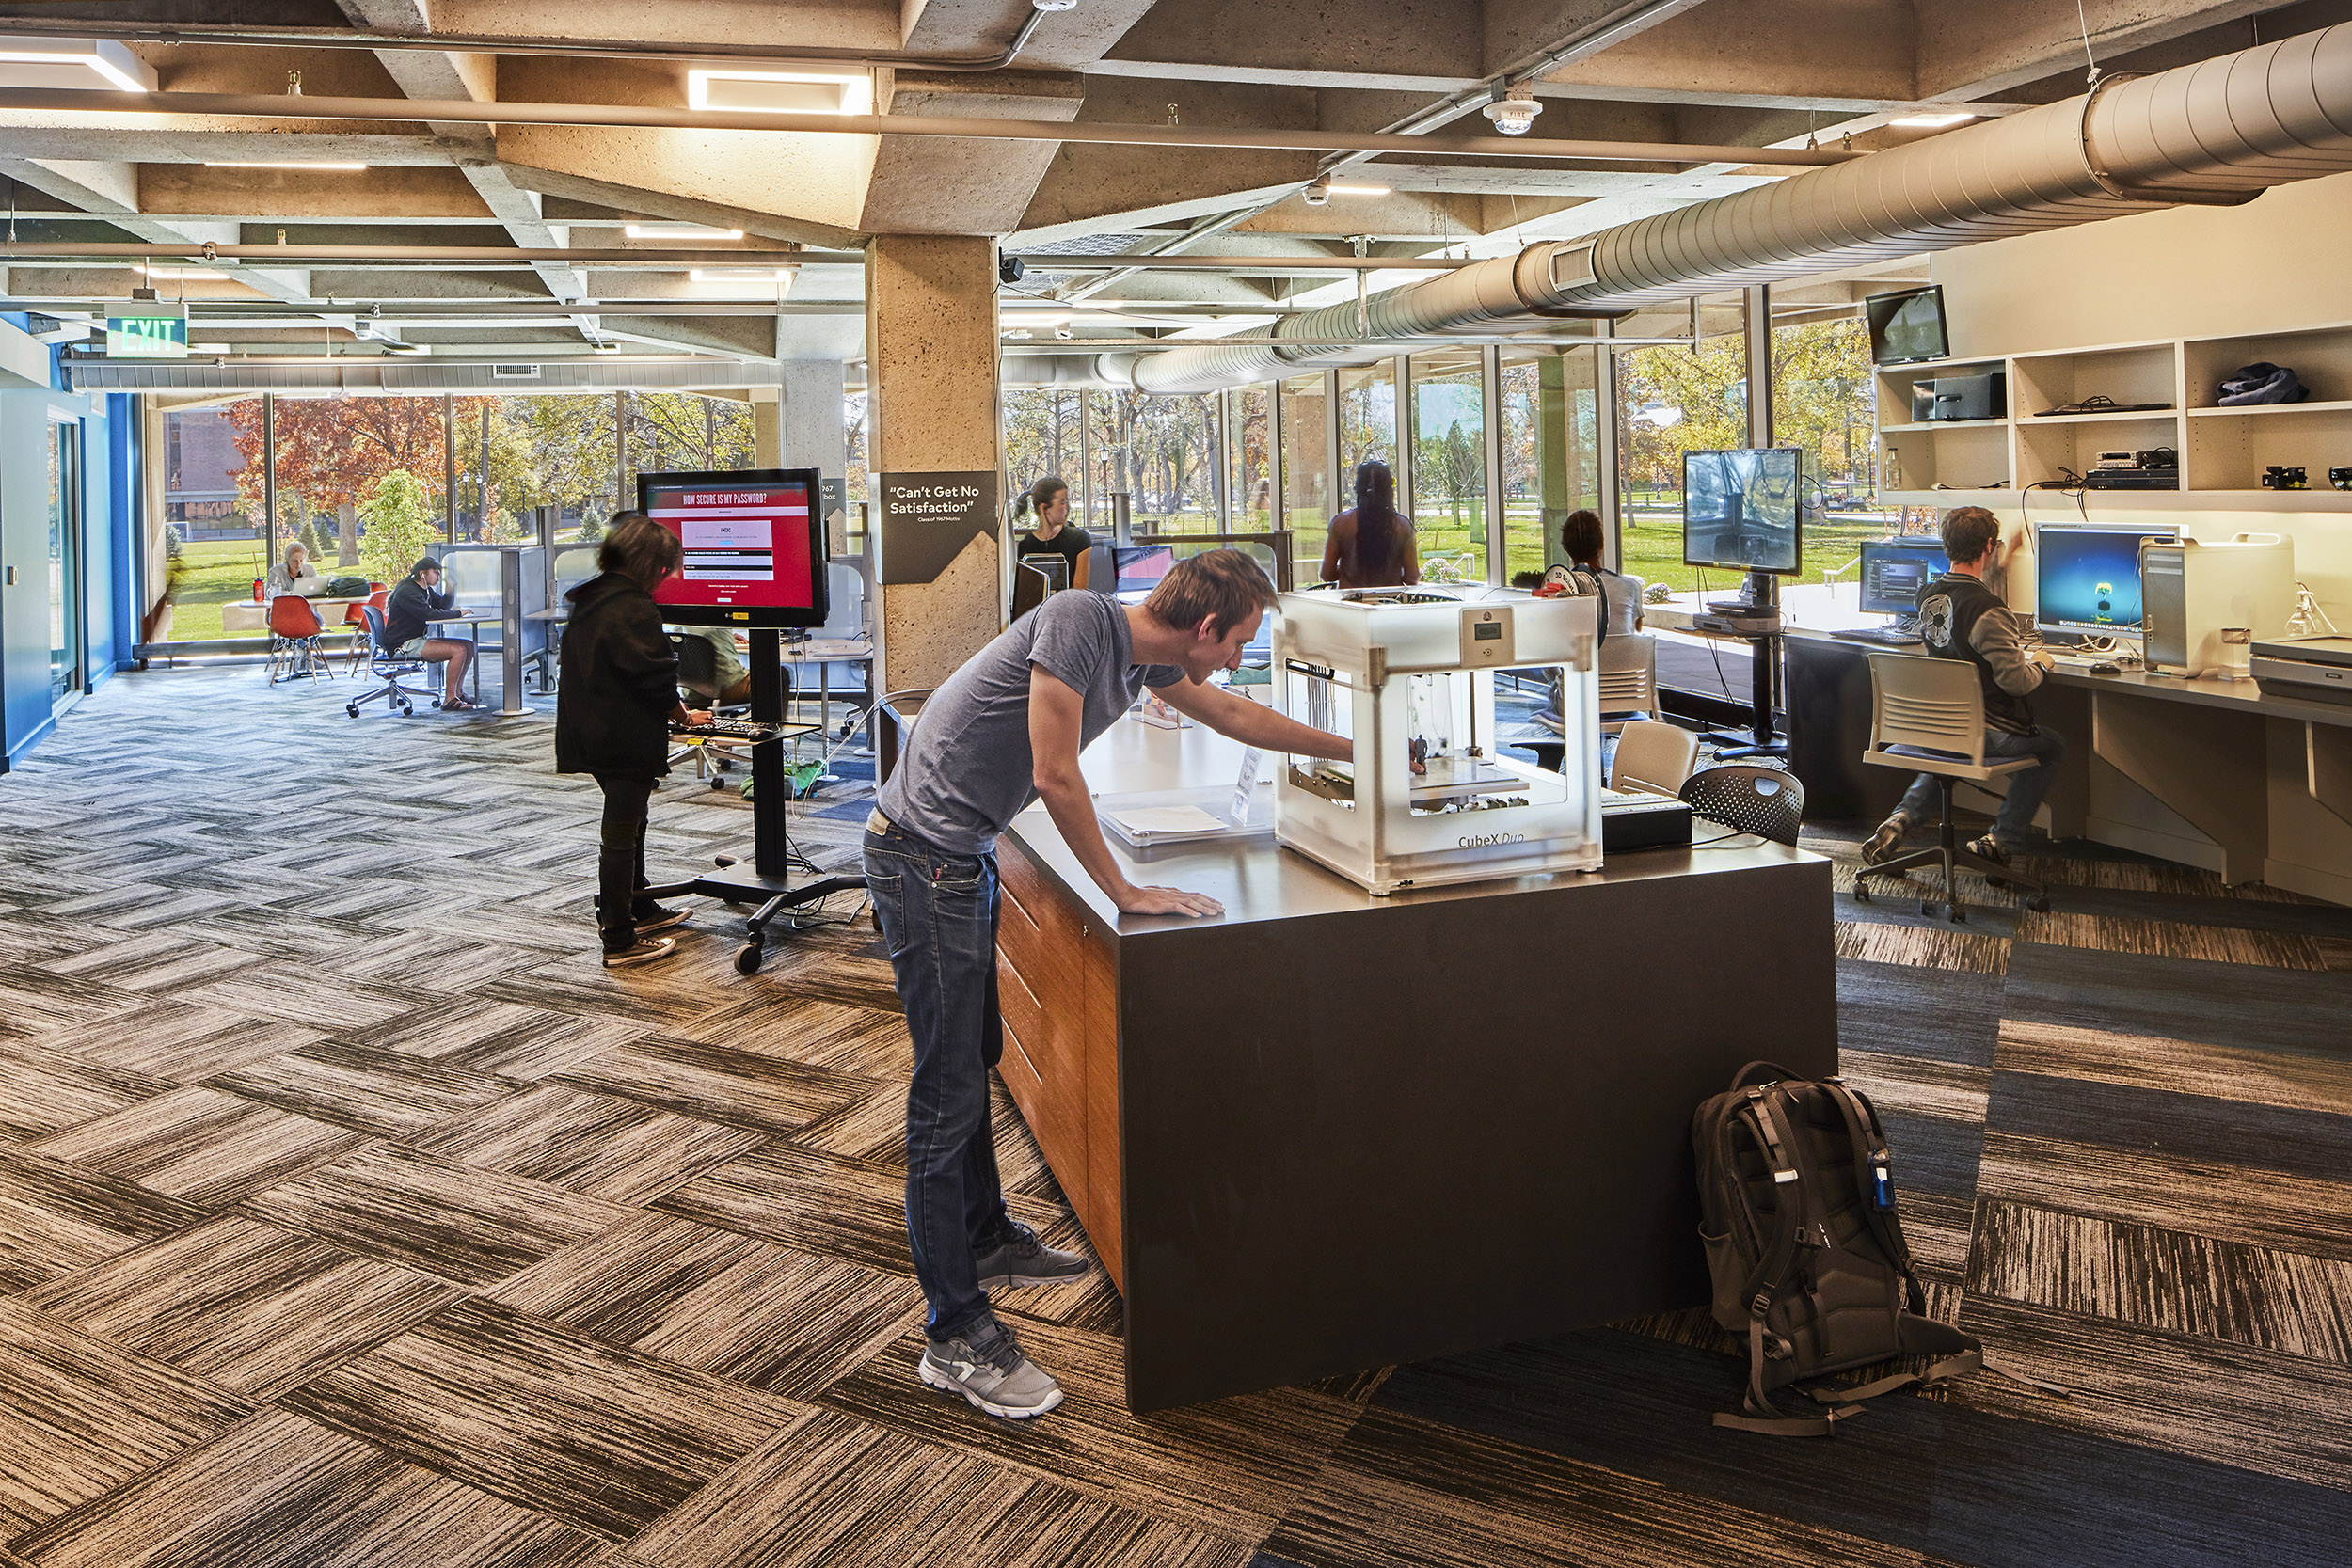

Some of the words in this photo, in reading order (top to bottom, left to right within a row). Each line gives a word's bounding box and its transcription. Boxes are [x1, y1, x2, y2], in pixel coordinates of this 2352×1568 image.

[121, 319, 176, 352] EXIT
[683, 494, 695, 505] HOW
[696, 494, 717, 505] SECURE
[717, 494, 723, 505] IS
[723, 494, 733, 504] MY
[734, 493, 767, 504] PASSWORD?
[889, 486, 931, 499] "Can't
[933, 485, 959, 498] Get
[961, 485, 979, 497] No
[890, 500, 974, 514] Satisfaction"
[1458, 833, 1499, 848] CubeX
[1502, 832, 1524, 845] Duo
